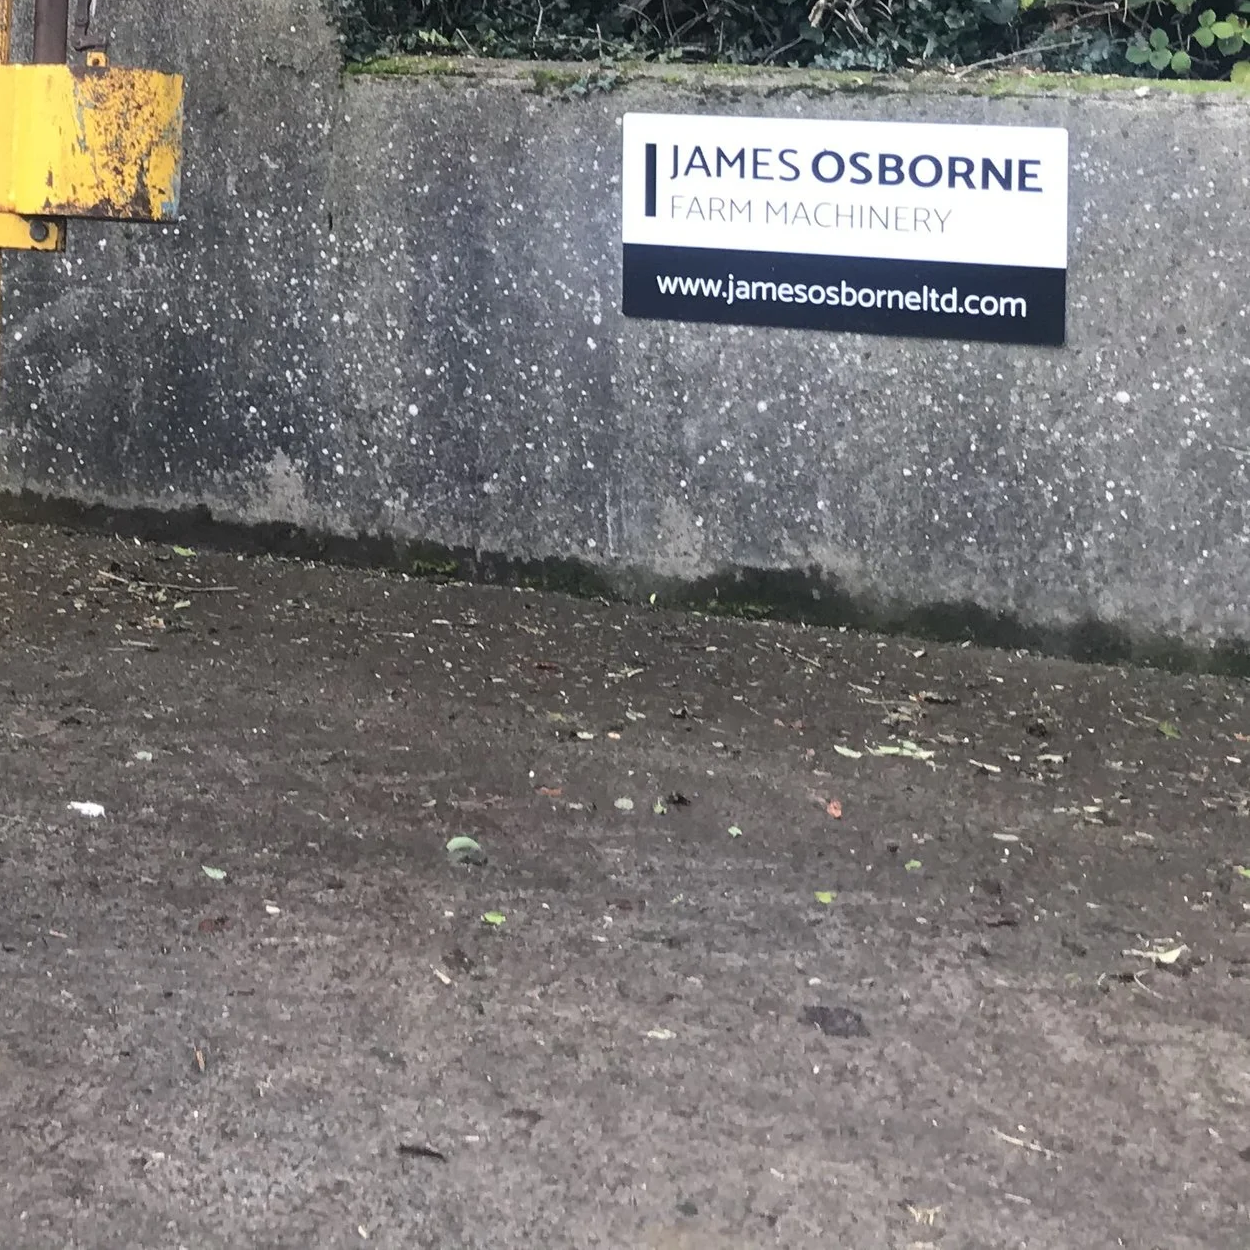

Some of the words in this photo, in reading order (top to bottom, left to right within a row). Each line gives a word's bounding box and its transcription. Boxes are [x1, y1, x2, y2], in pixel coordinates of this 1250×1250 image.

[670, 144, 800, 182] JAMES
[811, 149, 1043, 193] OSBORNE
[671, 195, 752, 223] FARM
[765, 200, 952, 234] MACHINERY
[656, 273, 1027, 318] www.jamesosborneltd.com
